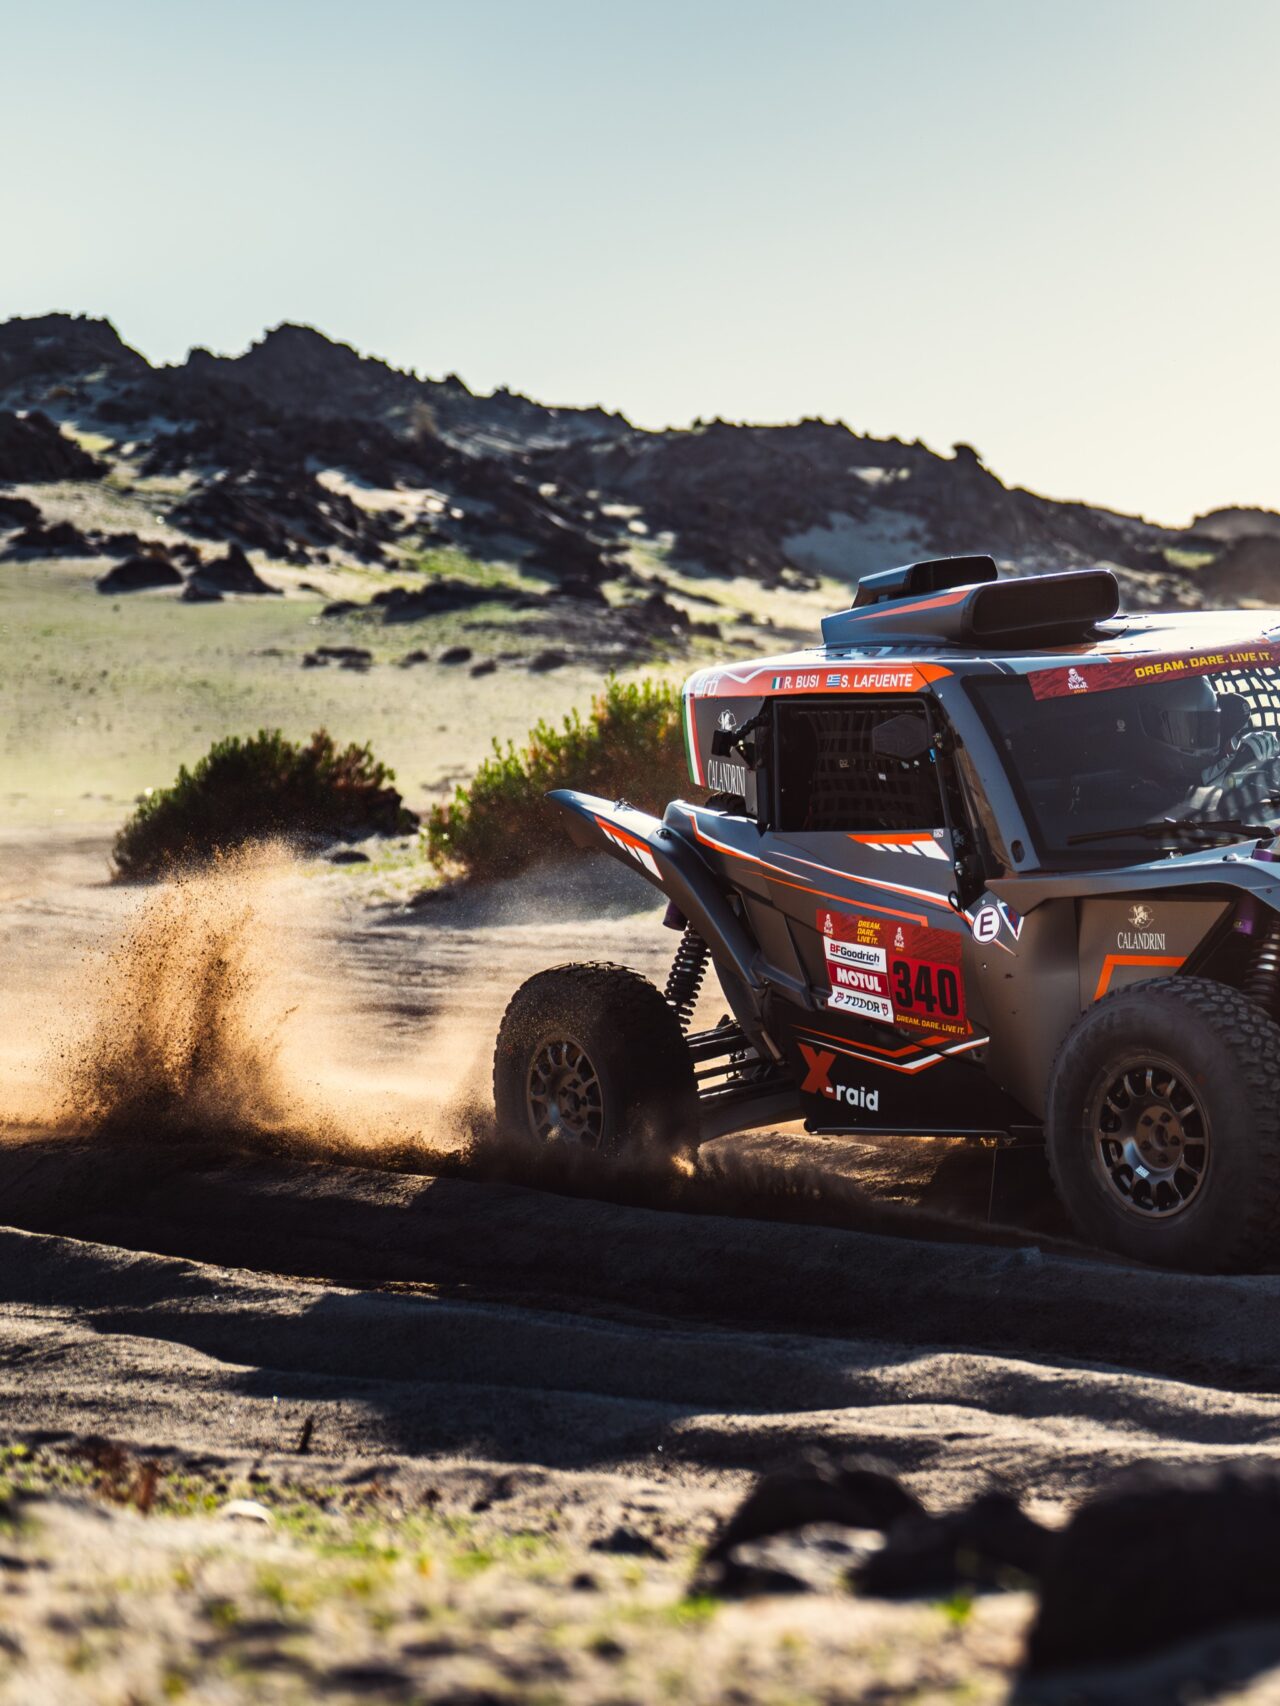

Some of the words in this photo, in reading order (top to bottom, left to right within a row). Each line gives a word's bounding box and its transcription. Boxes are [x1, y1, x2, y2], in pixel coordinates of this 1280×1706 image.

[1134, 660, 1188, 678] DREAM.
[1190, 654, 1228, 668] DARE.
[1229, 652, 1257, 664] LIVE
[1259, 651, 1273, 661] IT.
[784, 676, 793, 689] R.
[795, 675, 819, 689] BUSI
[840, 674, 850, 687] S.
[854, 673, 913, 687] LAFUENTE
[707, 759, 746, 797] CALANDRINI
[857, 928, 875, 937] DARE.
[858, 920, 881, 930] DREAM.
[979, 911, 994, 937] E
[857, 935, 871, 944] LIVE
[1117, 931, 1166, 951] CALANDRINI
[830, 943, 880, 963] BFGoodrich
[836, 967, 882, 992] MOTUL
[892, 960, 960, 1017] 340
[844, 994, 881, 1013] TUDOR
[896, 1014, 920, 1026] DREAM.
[921, 1020, 941, 1030] DARE.
[942, 1023, 957, 1033] LIVE
[797, 1042, 879, 1112] X-raid
